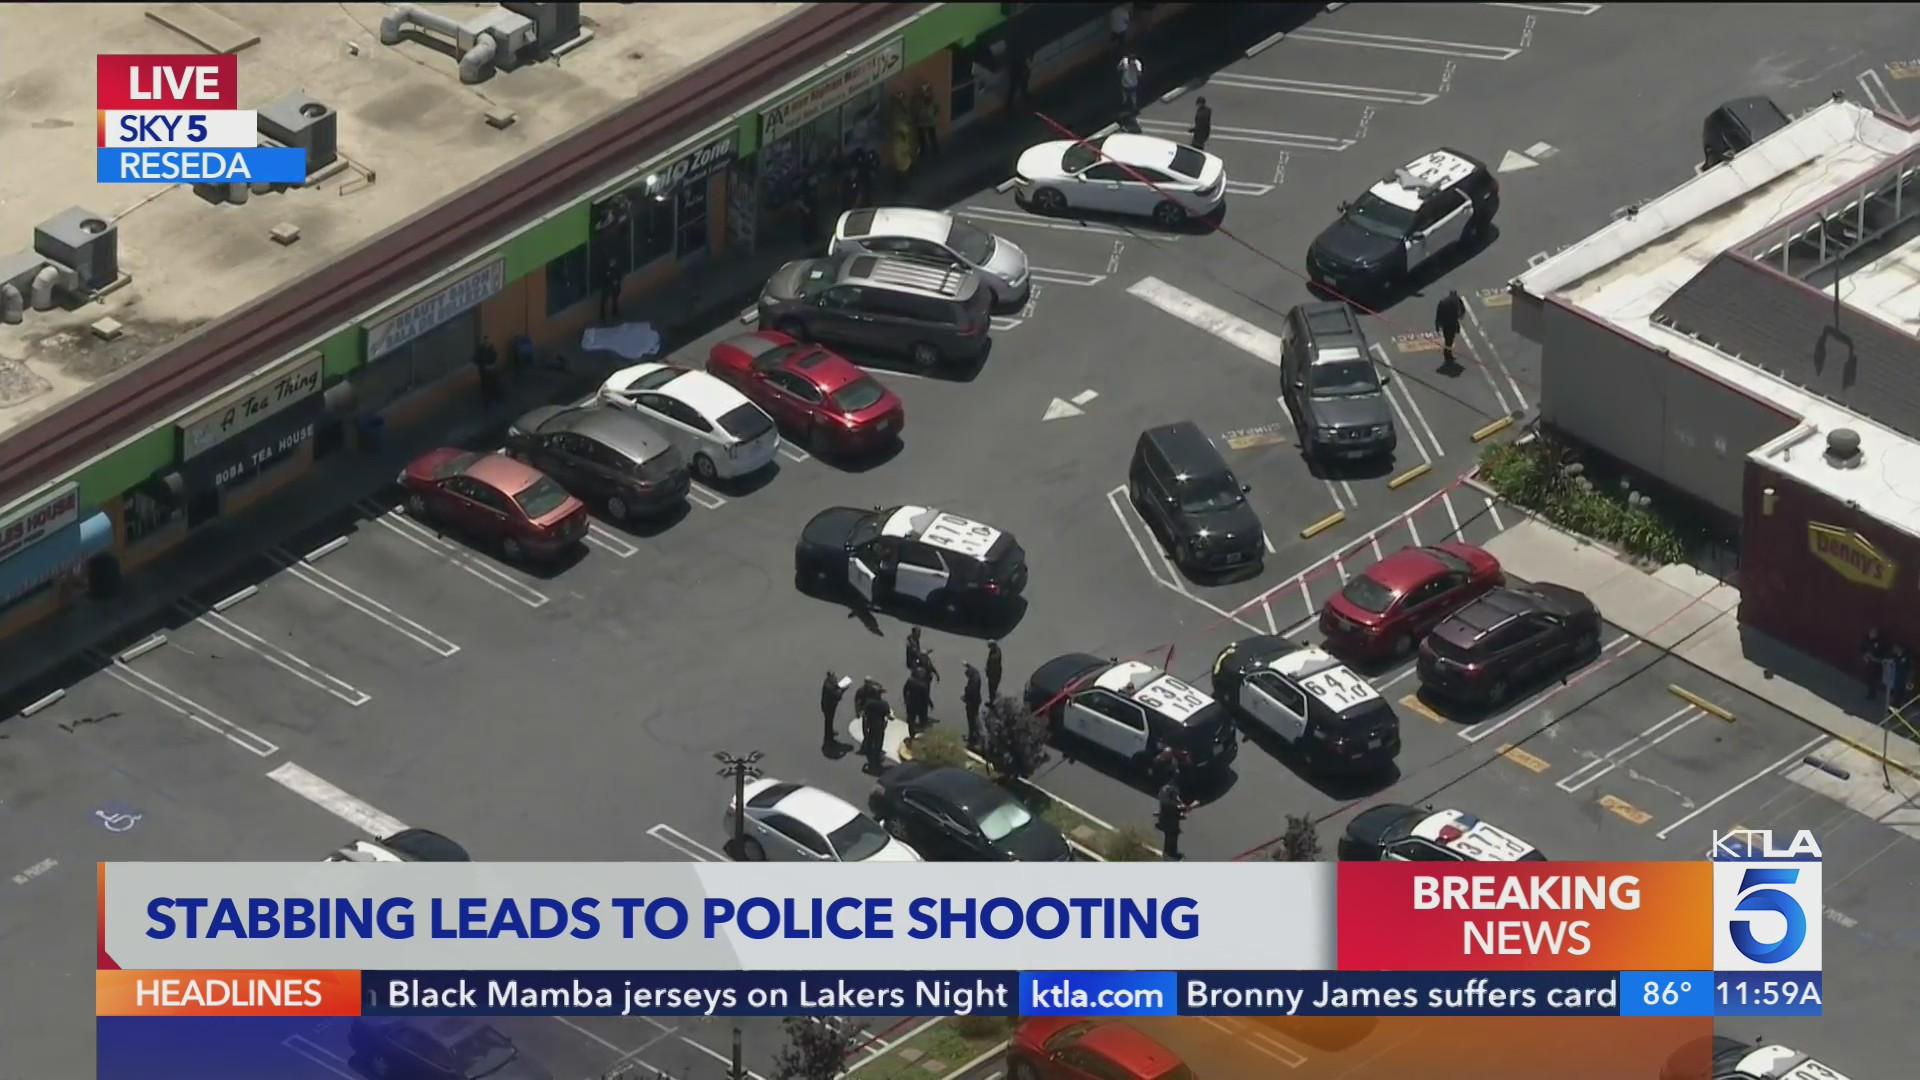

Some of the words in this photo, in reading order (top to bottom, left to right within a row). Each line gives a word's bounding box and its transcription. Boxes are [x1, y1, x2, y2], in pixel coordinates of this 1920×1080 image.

[220, 408, 236, 431] A
[241, 396, 269, 417] Tea
[274, 371, 319, 400] Thing
[215, 462, 244, 486] BOBA
[252, 446, 273, 466] TEA
[278, 423, 315, 452] HOUSE
[27, 493, 76, 533] HOUSE
[1817, 531, 1884, 580] Denny's
[1138, 678, 1190, 708] 630
[1304, 668, 1361, 696] 641
[1457, 825, 1505, 855] 377
